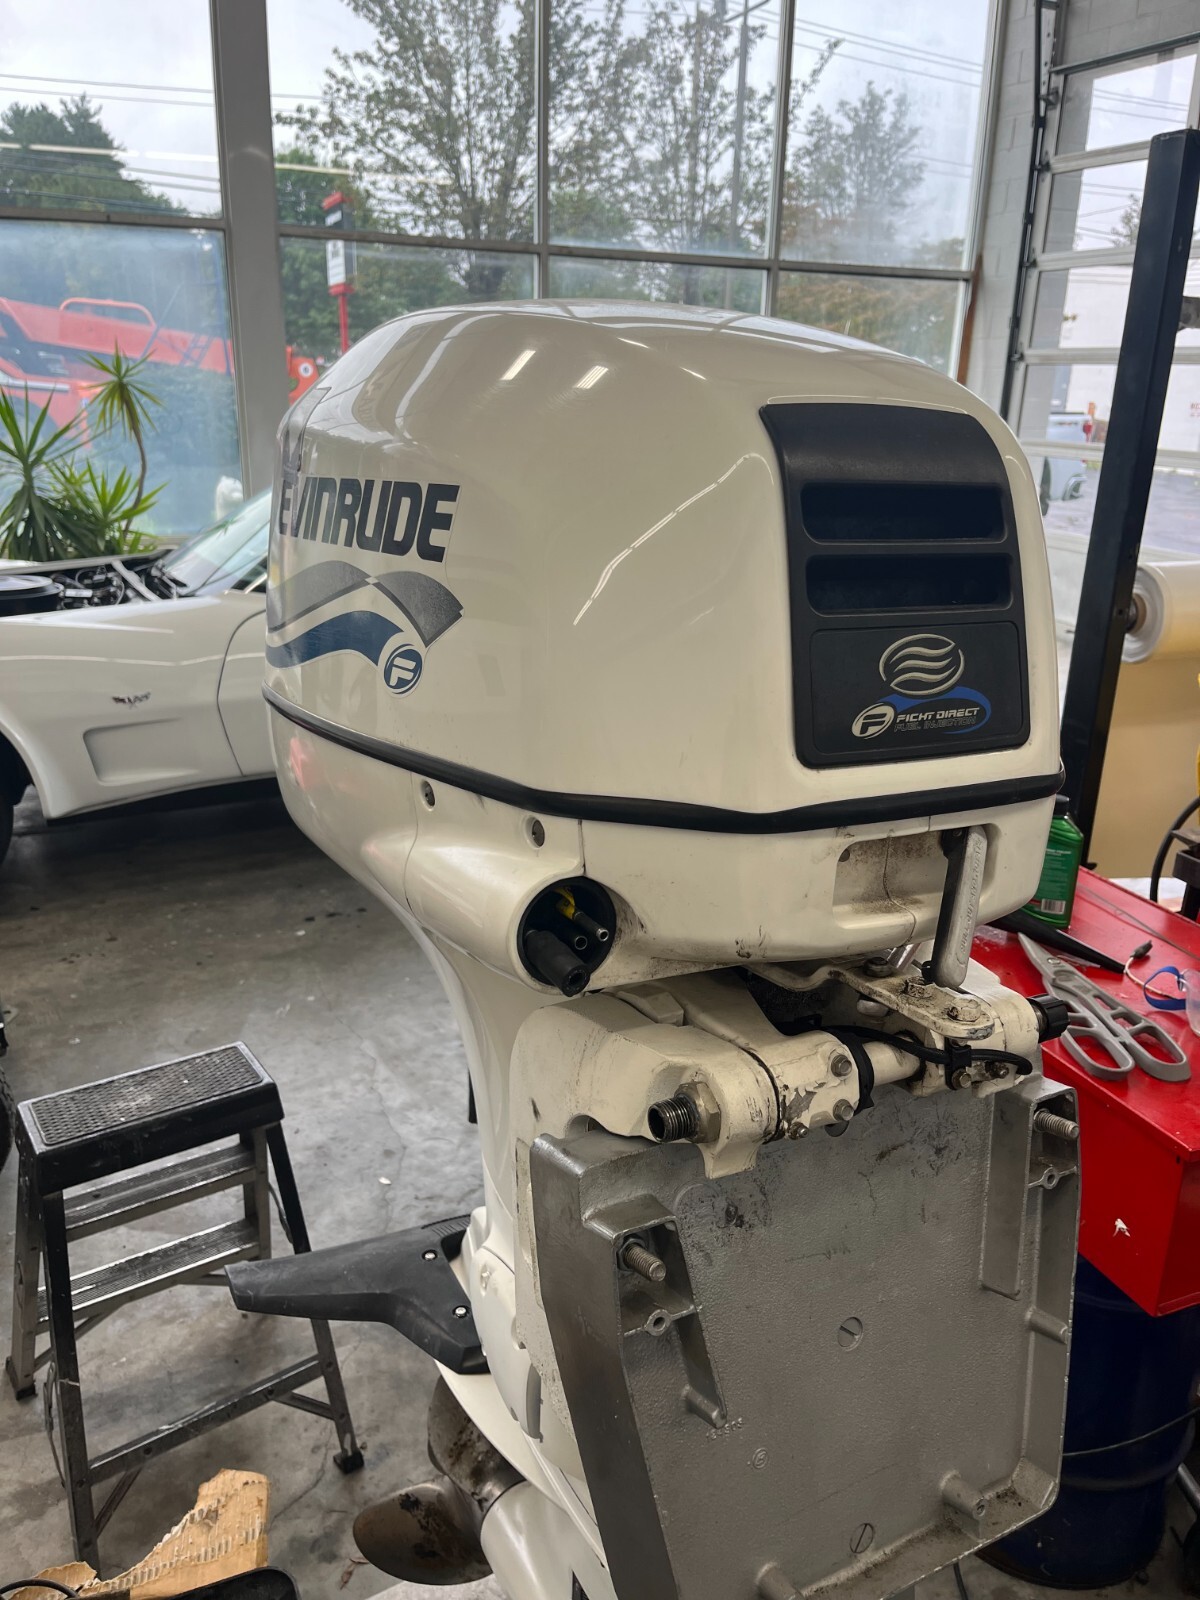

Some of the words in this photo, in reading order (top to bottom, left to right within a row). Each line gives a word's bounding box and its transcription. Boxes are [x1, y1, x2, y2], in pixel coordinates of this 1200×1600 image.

[279, 476, 460, 563] EVINRUDE
[896, 711, 935, 723] FICHT
[936, 707, 980, 719] DIRECT
